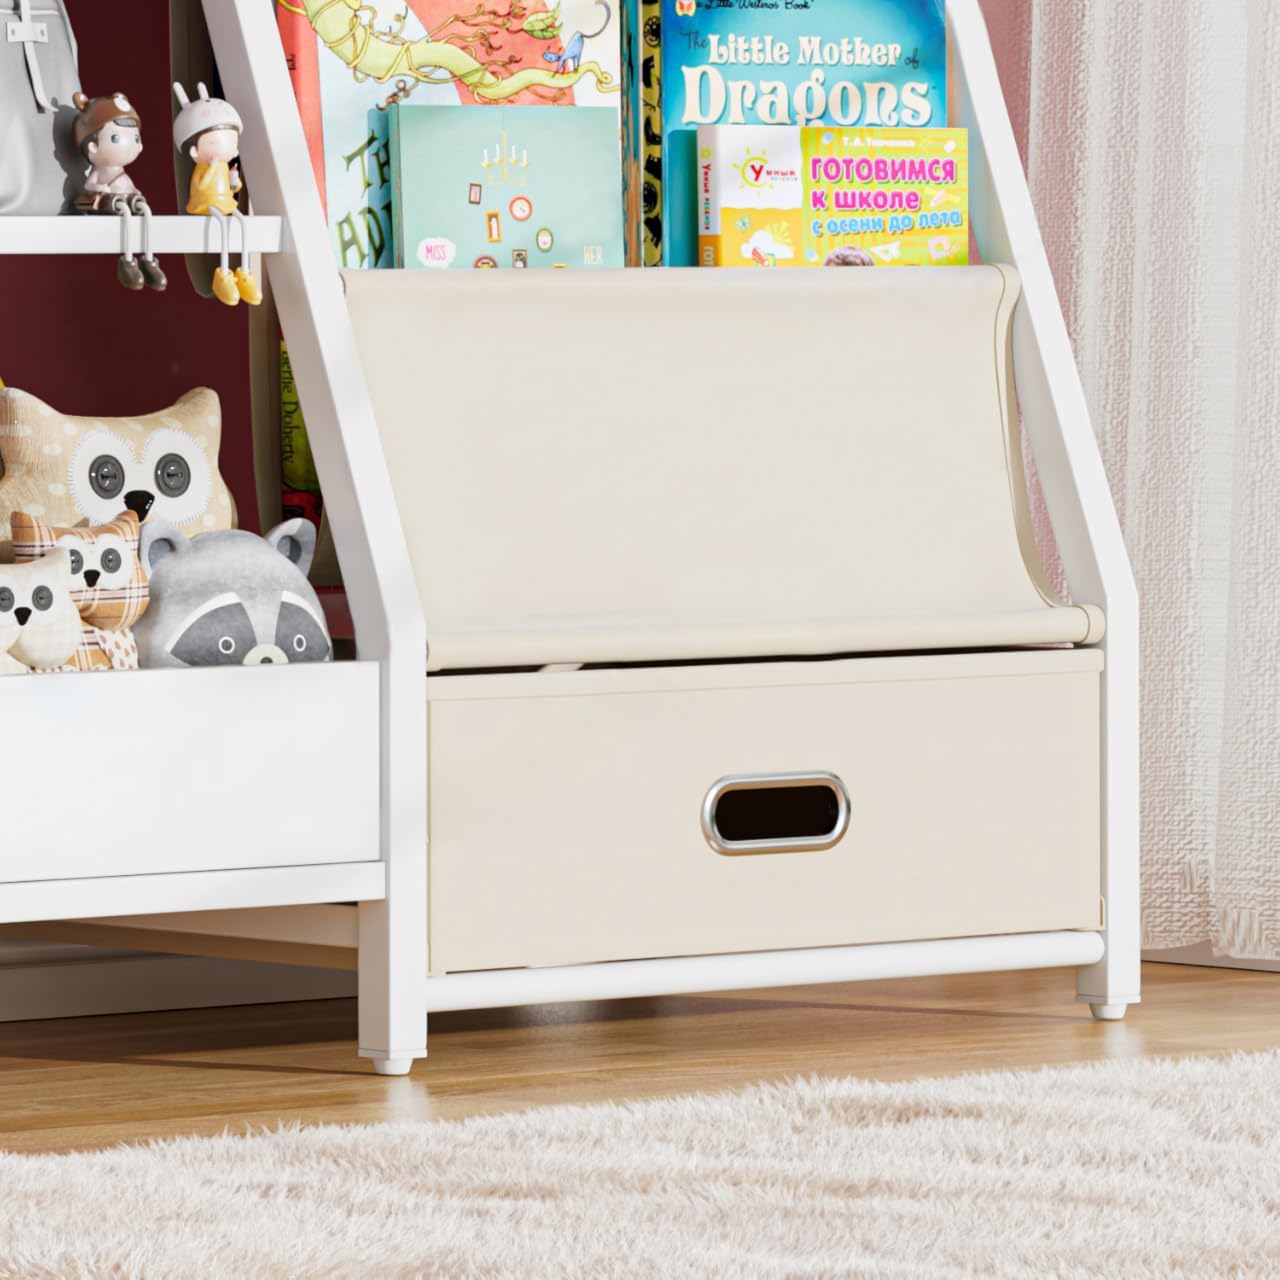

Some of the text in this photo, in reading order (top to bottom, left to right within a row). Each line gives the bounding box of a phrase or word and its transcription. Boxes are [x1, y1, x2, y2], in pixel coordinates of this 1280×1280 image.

[680, 28, 920, 70] The Little Mother of
[680, 63, 933, 128] Dragons
[811, 157, 956, 182] ГОТОВИМСЯ
[834, 190, 920, 211] школе
[826, 216, 883, 234] осени
[888, 214, 914, 233] до
[918, 211, 962, 228] лета
[425, 244, 447, 262] MISS
